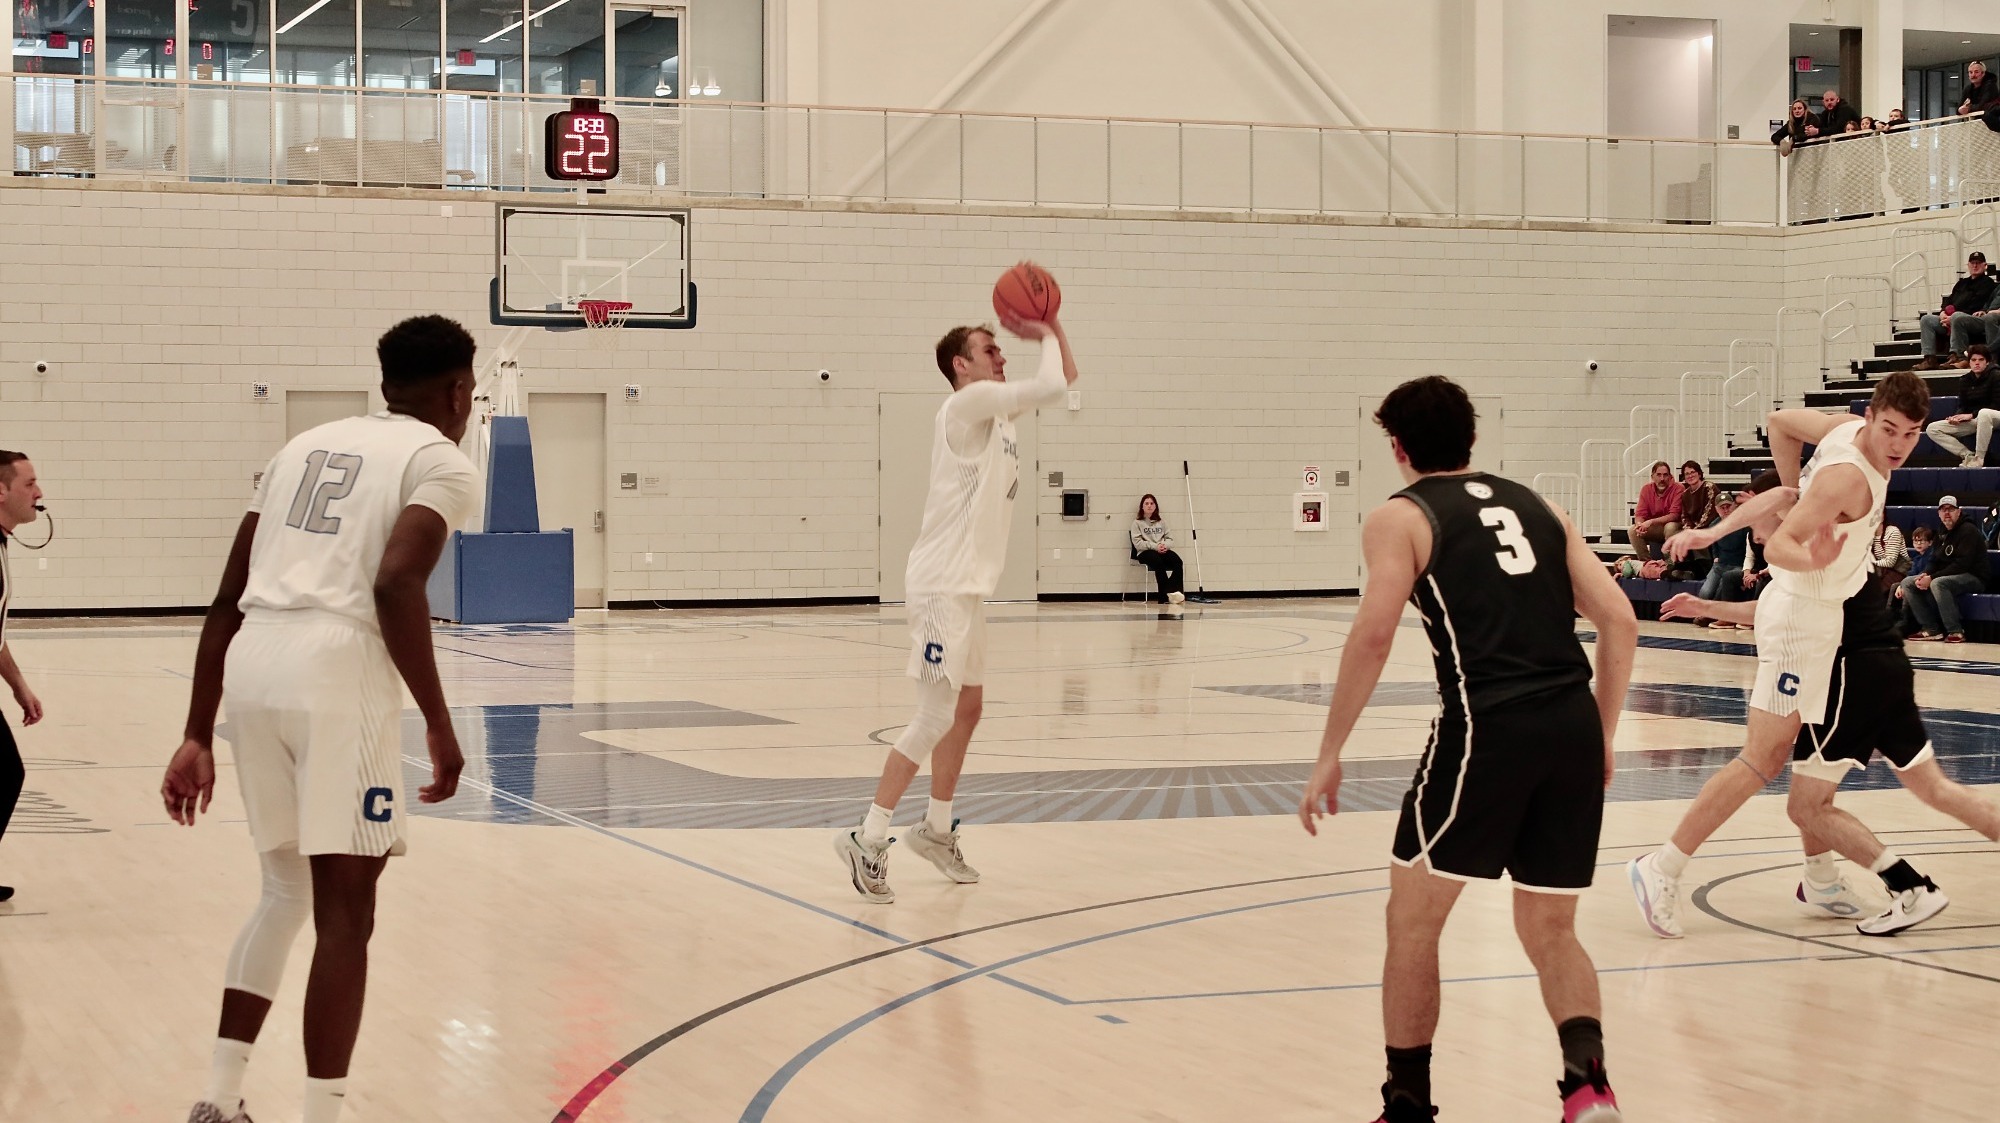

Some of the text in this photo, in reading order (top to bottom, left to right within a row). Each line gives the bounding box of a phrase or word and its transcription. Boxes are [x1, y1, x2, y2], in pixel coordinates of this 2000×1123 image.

[562, 134, 610, 174] 22
[285, 449, 363, 535] 12
[1478, 506, 1537, 576] 3
[924, 642, 944, 664] C
[1777, 672, 1800, 697] C
[363, 787, 393, 823] C
